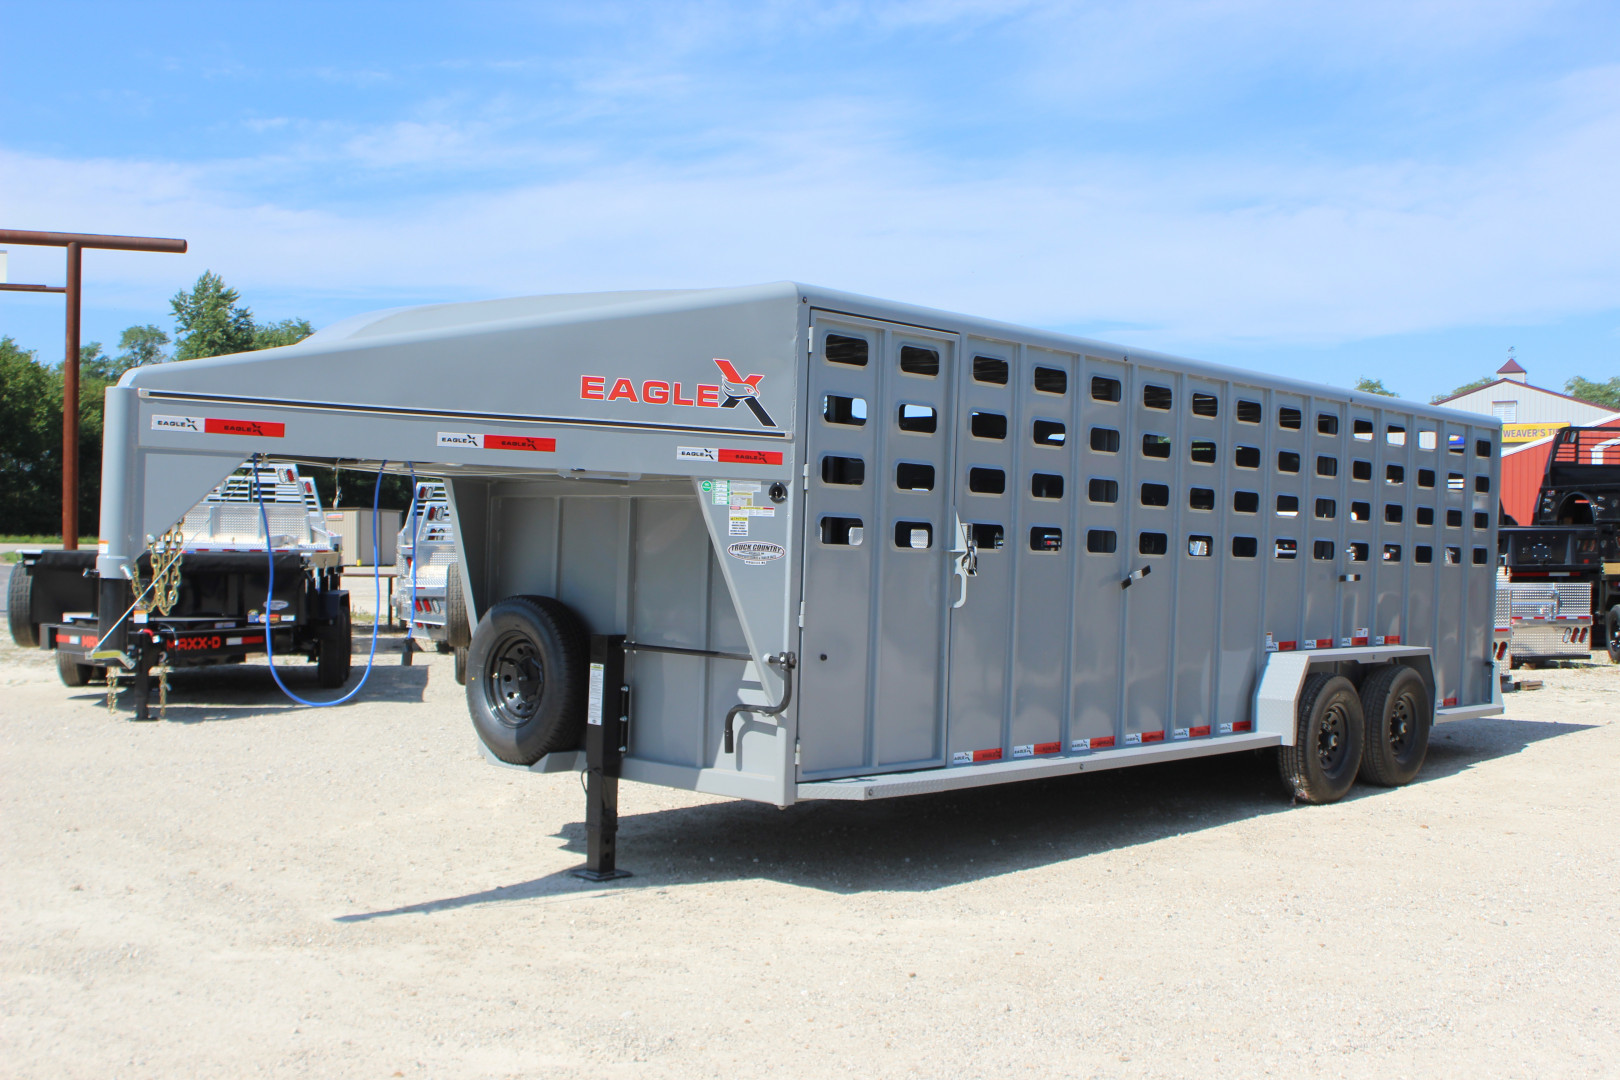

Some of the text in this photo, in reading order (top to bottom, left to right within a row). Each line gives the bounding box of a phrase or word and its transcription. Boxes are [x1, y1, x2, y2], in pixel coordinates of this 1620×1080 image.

[1502, 428, 1546, 438] WEAVER'S
[752, 544, 782, 553] COUNTRY
[166, 636, 221, 651] MAXX-D
